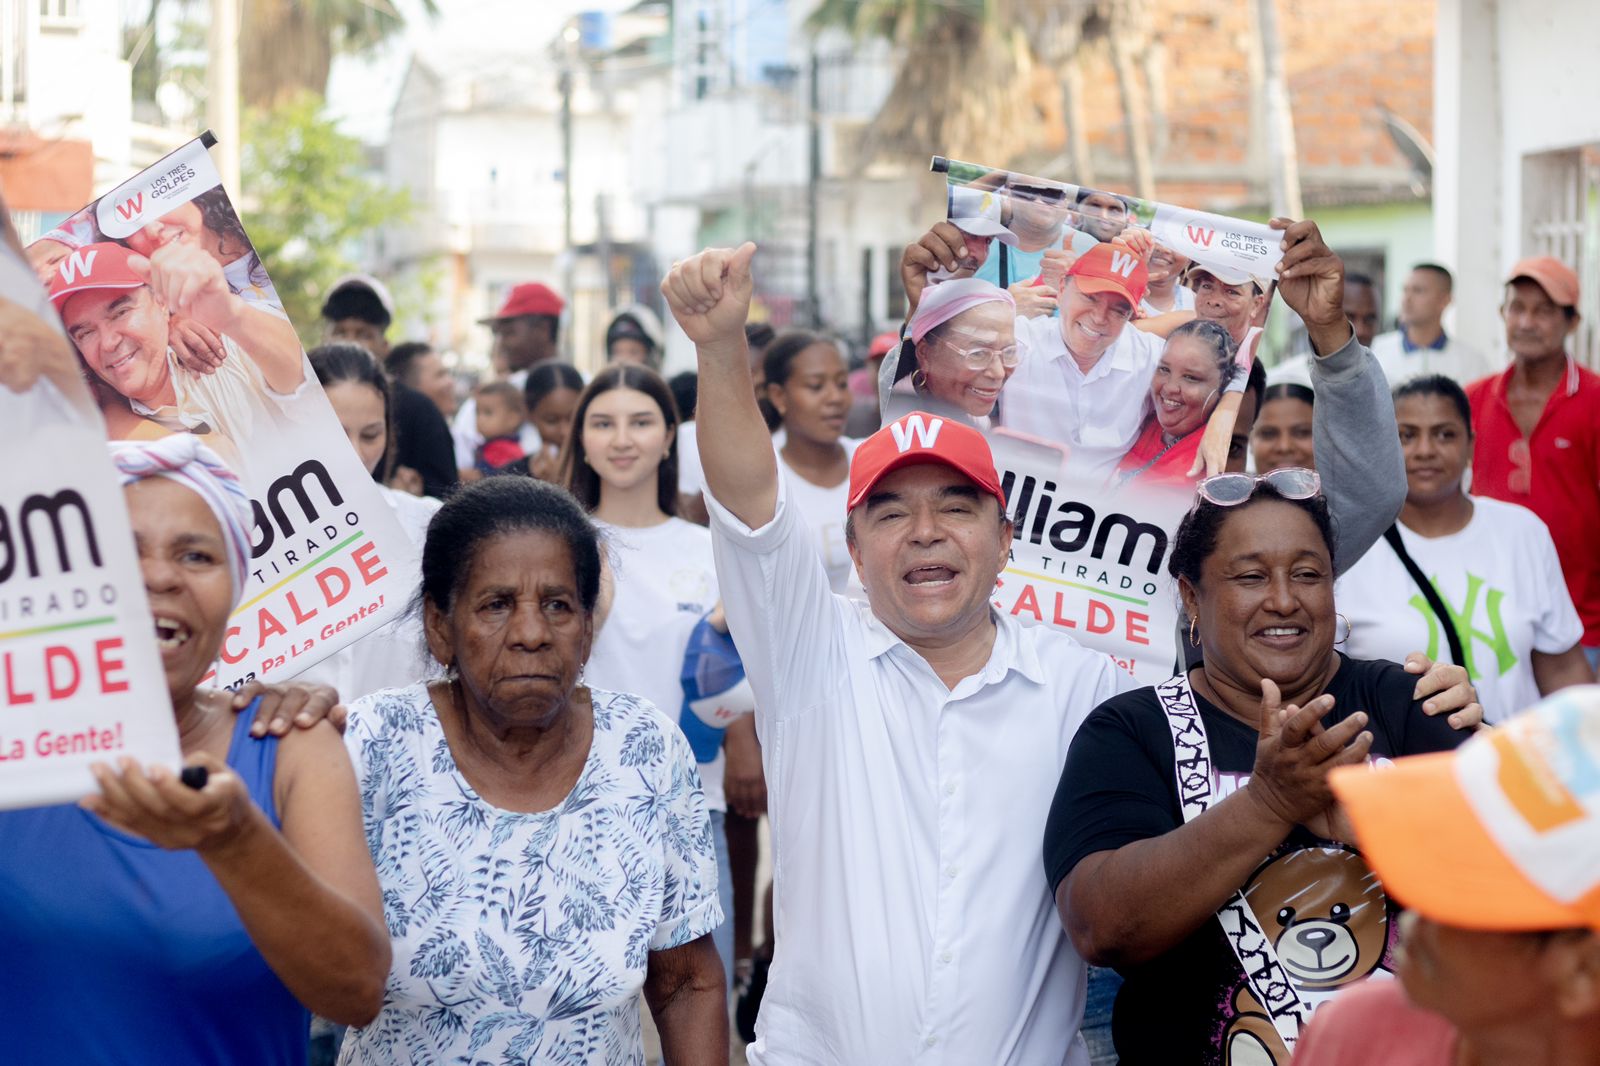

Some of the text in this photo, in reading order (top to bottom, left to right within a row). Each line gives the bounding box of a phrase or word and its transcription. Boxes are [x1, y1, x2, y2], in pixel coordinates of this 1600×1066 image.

[151, 163, 188, 190] LOS TRES
[151, 168, 196, 199] GOLPES
[116, 192, 143, 220] W
[1187, 224, 1215, 247] W
[1221, 239, 1268, 256] GOLPES
[1225, 231, 1264, 245] LOS TRES
[59, 249, 98, 285] W
[1109, 249, 1139, 279] W
[889, 415, 943, 453] W
[253, 511, 359, 583] TIRADO
[1042, 556, 1157, 596] TIRADO
[197, 541, 388, 685] CALDE
[291, 638, 314, 658] La
[320, 595, 385, 641] Gente!
[995, 578, 1150, 645] ALDE
[4, 637, 130, 706] LDE
[35, 722, 124, 757] Gente!
